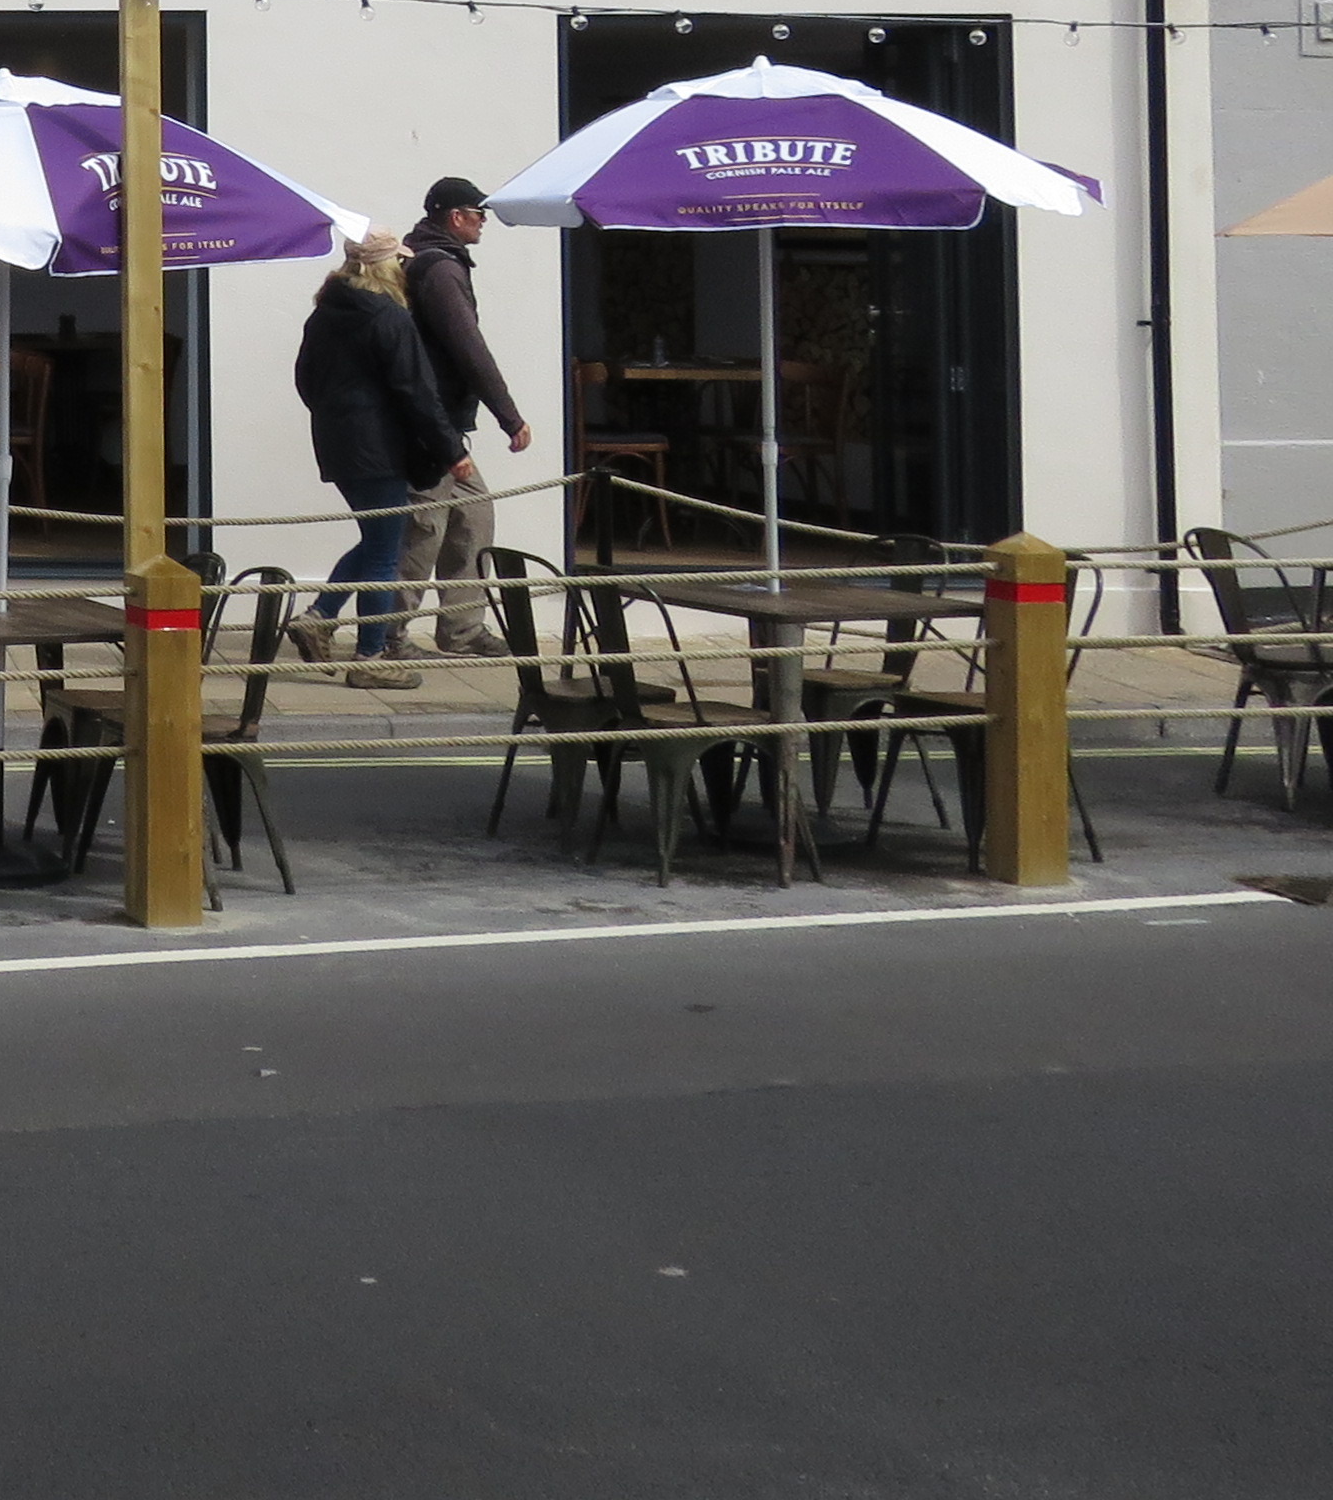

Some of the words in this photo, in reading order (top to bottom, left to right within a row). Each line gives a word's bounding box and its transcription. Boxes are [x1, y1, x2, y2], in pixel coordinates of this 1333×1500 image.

[676, 140, 858, 170] TRIBUTE
[80, 153, 217, 192] TRUTE
[705, 167, 766, 180] CORNISH
[770, 167, 802, 175] PALE
[805, 167, 832, 177] ALE
[179, 193, 204, 208] ALE
[677, 205, 733, 215] QUALITY
[736, 201, 785, 212] SPEAKS
[790, 201, 816, 210] FOR
[820, 201, 865, 211] ITSELF
[172, 241, 195, 251] FOR
[198, 239, 236, 249] ITSELF
